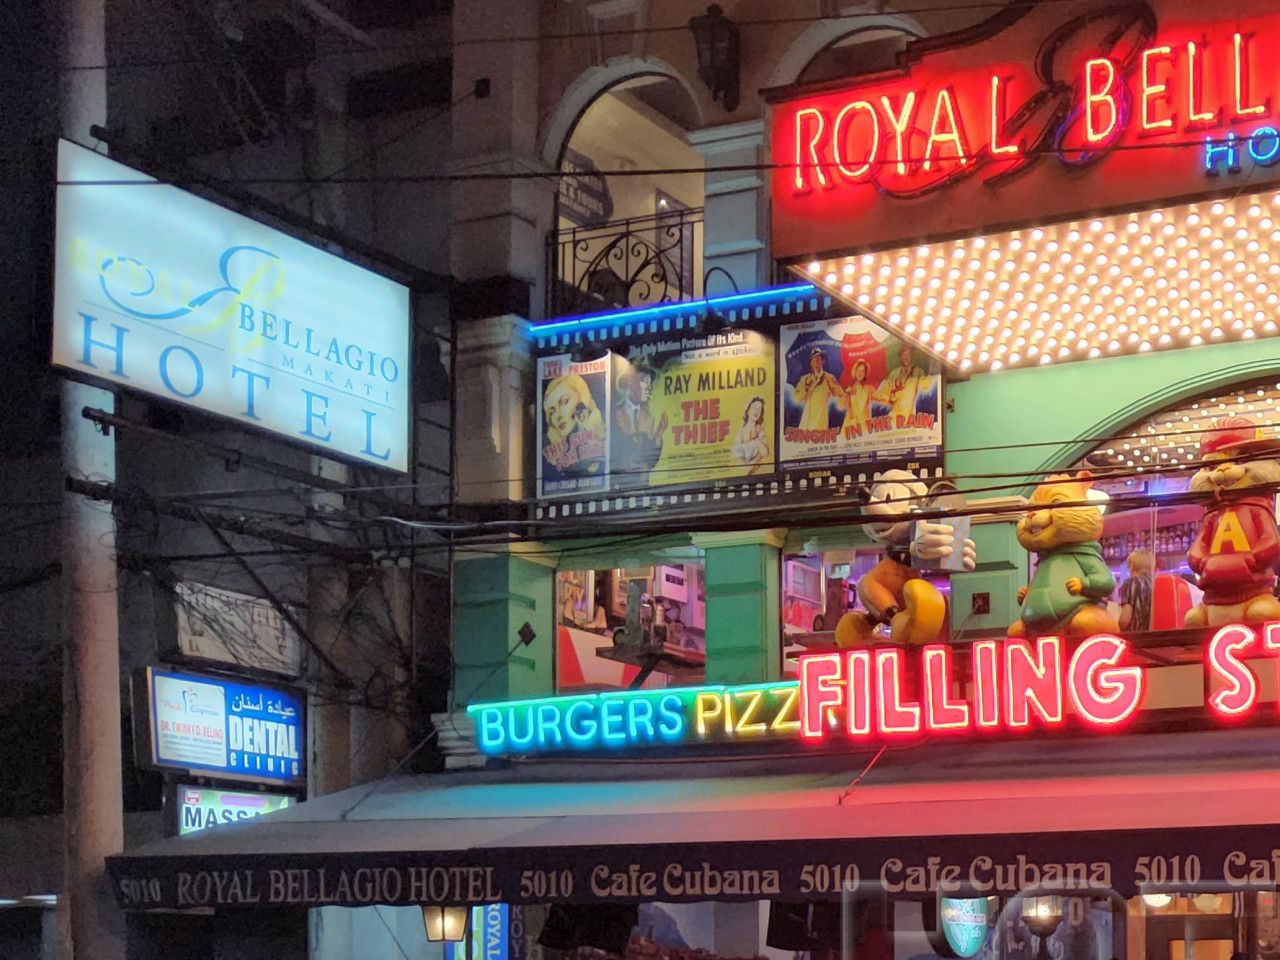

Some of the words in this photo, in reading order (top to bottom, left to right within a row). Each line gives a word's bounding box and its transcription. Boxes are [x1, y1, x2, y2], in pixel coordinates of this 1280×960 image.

[795, 74, 1018, 190] ROYAL
[238, 301, 399, 384] BELLAGIO
[728, 332, 743, 344] Kind
[77, 311, 391, 461] HOTEL
[282, 355, 391, 402] MAKATI
[664, 372, 692, 396] RAY
[697, 366, 767, 393] MILLAND
[671, 419, 731, 446] THIEF
[681, 398, 721, 422] THE
[844, 421, 863, 441] IN
[865, 414, 893, 434] THE
[896, 411, 936, 431] RAIN
[1210, 511, 1251, 555] A
[798, 631, 1145, 741] FILLING
[228, 714, 299, 759] DENTAL
[480, 694, 684, 749] BURGERS
[696, 687, 802, 736] PIZZ
[230, 751, 299, 776] CLINIC
[120, 877, 161, 905] 5010
[177, 869, 262, 906] ROYAL
[269, 868, 400, 904] BELLAGIO
[401, 866, 501, 902] HOTEL
[520, 870, 574, 899] 5010
[590, 864, 657, 897] Cafe
[663, 862, 780, 896] Cubana
[800, 863, 860, 893] 5010
[880, 857, 961, 893] Cafe
[966, 855, 1112, 892] Cubana
[1134, 853, 1201, 886] 5010
